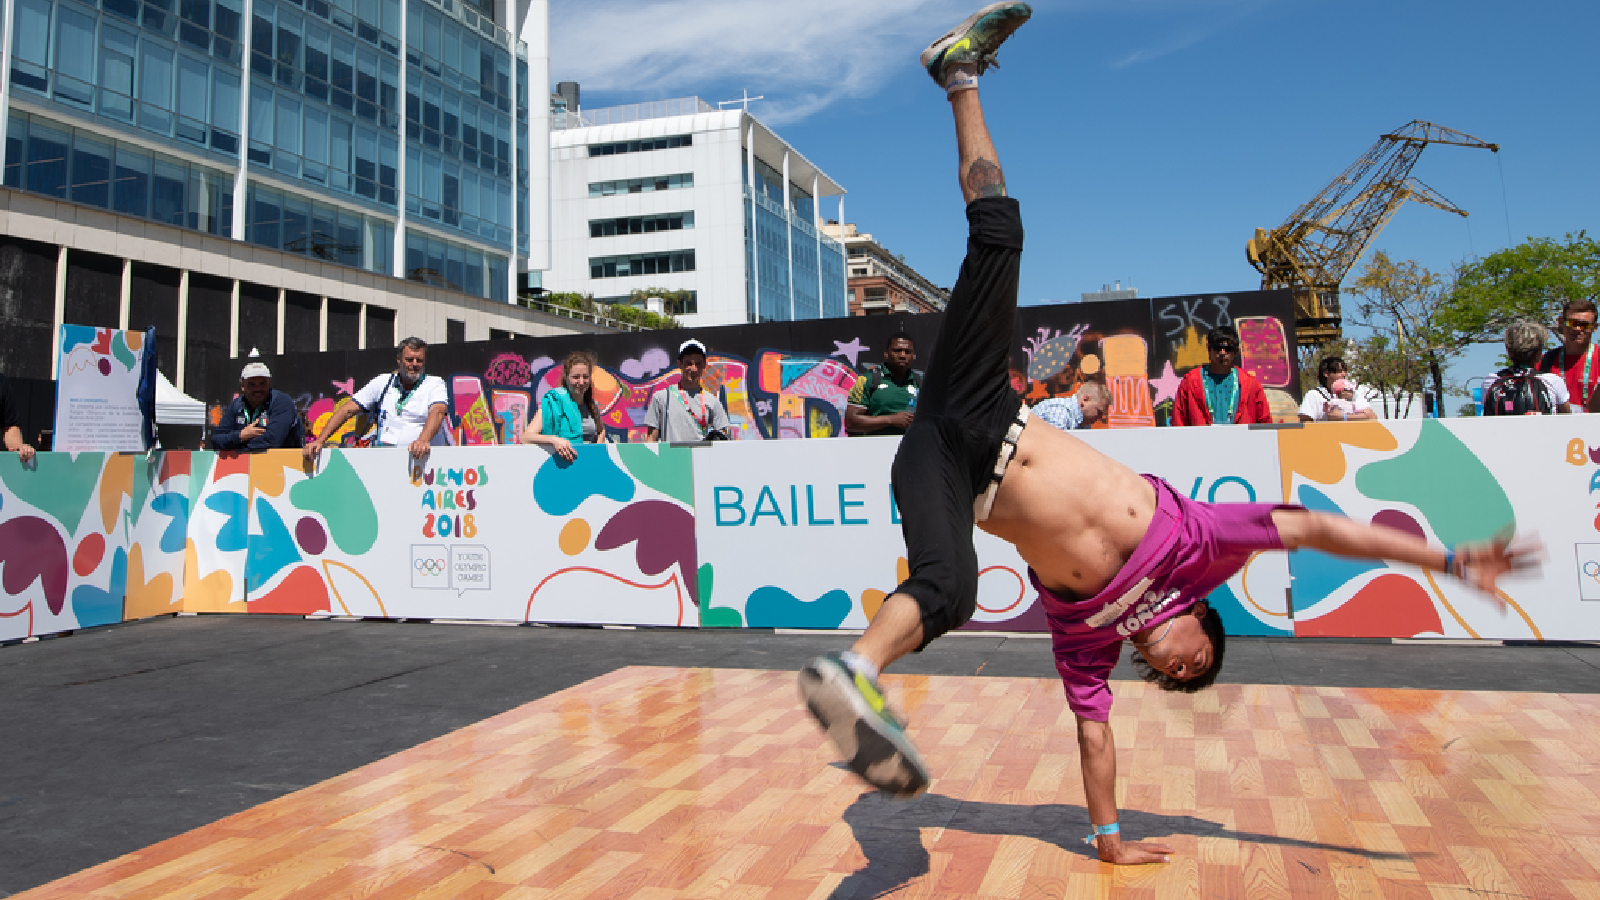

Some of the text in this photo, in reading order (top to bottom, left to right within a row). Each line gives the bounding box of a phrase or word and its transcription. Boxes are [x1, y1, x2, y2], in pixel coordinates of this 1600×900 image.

[409, 465, 488, 487] BUENOS
[421, 488, 477, 511] AIRES
[713, 484, 869, 526] BAILE
[422, 513, 477, 538] 2018
[454, 563, 487, 572] OLYMPIC
[457, 553, 484, 561] YOUTH
[457, 574, 484, 582] GAMES
